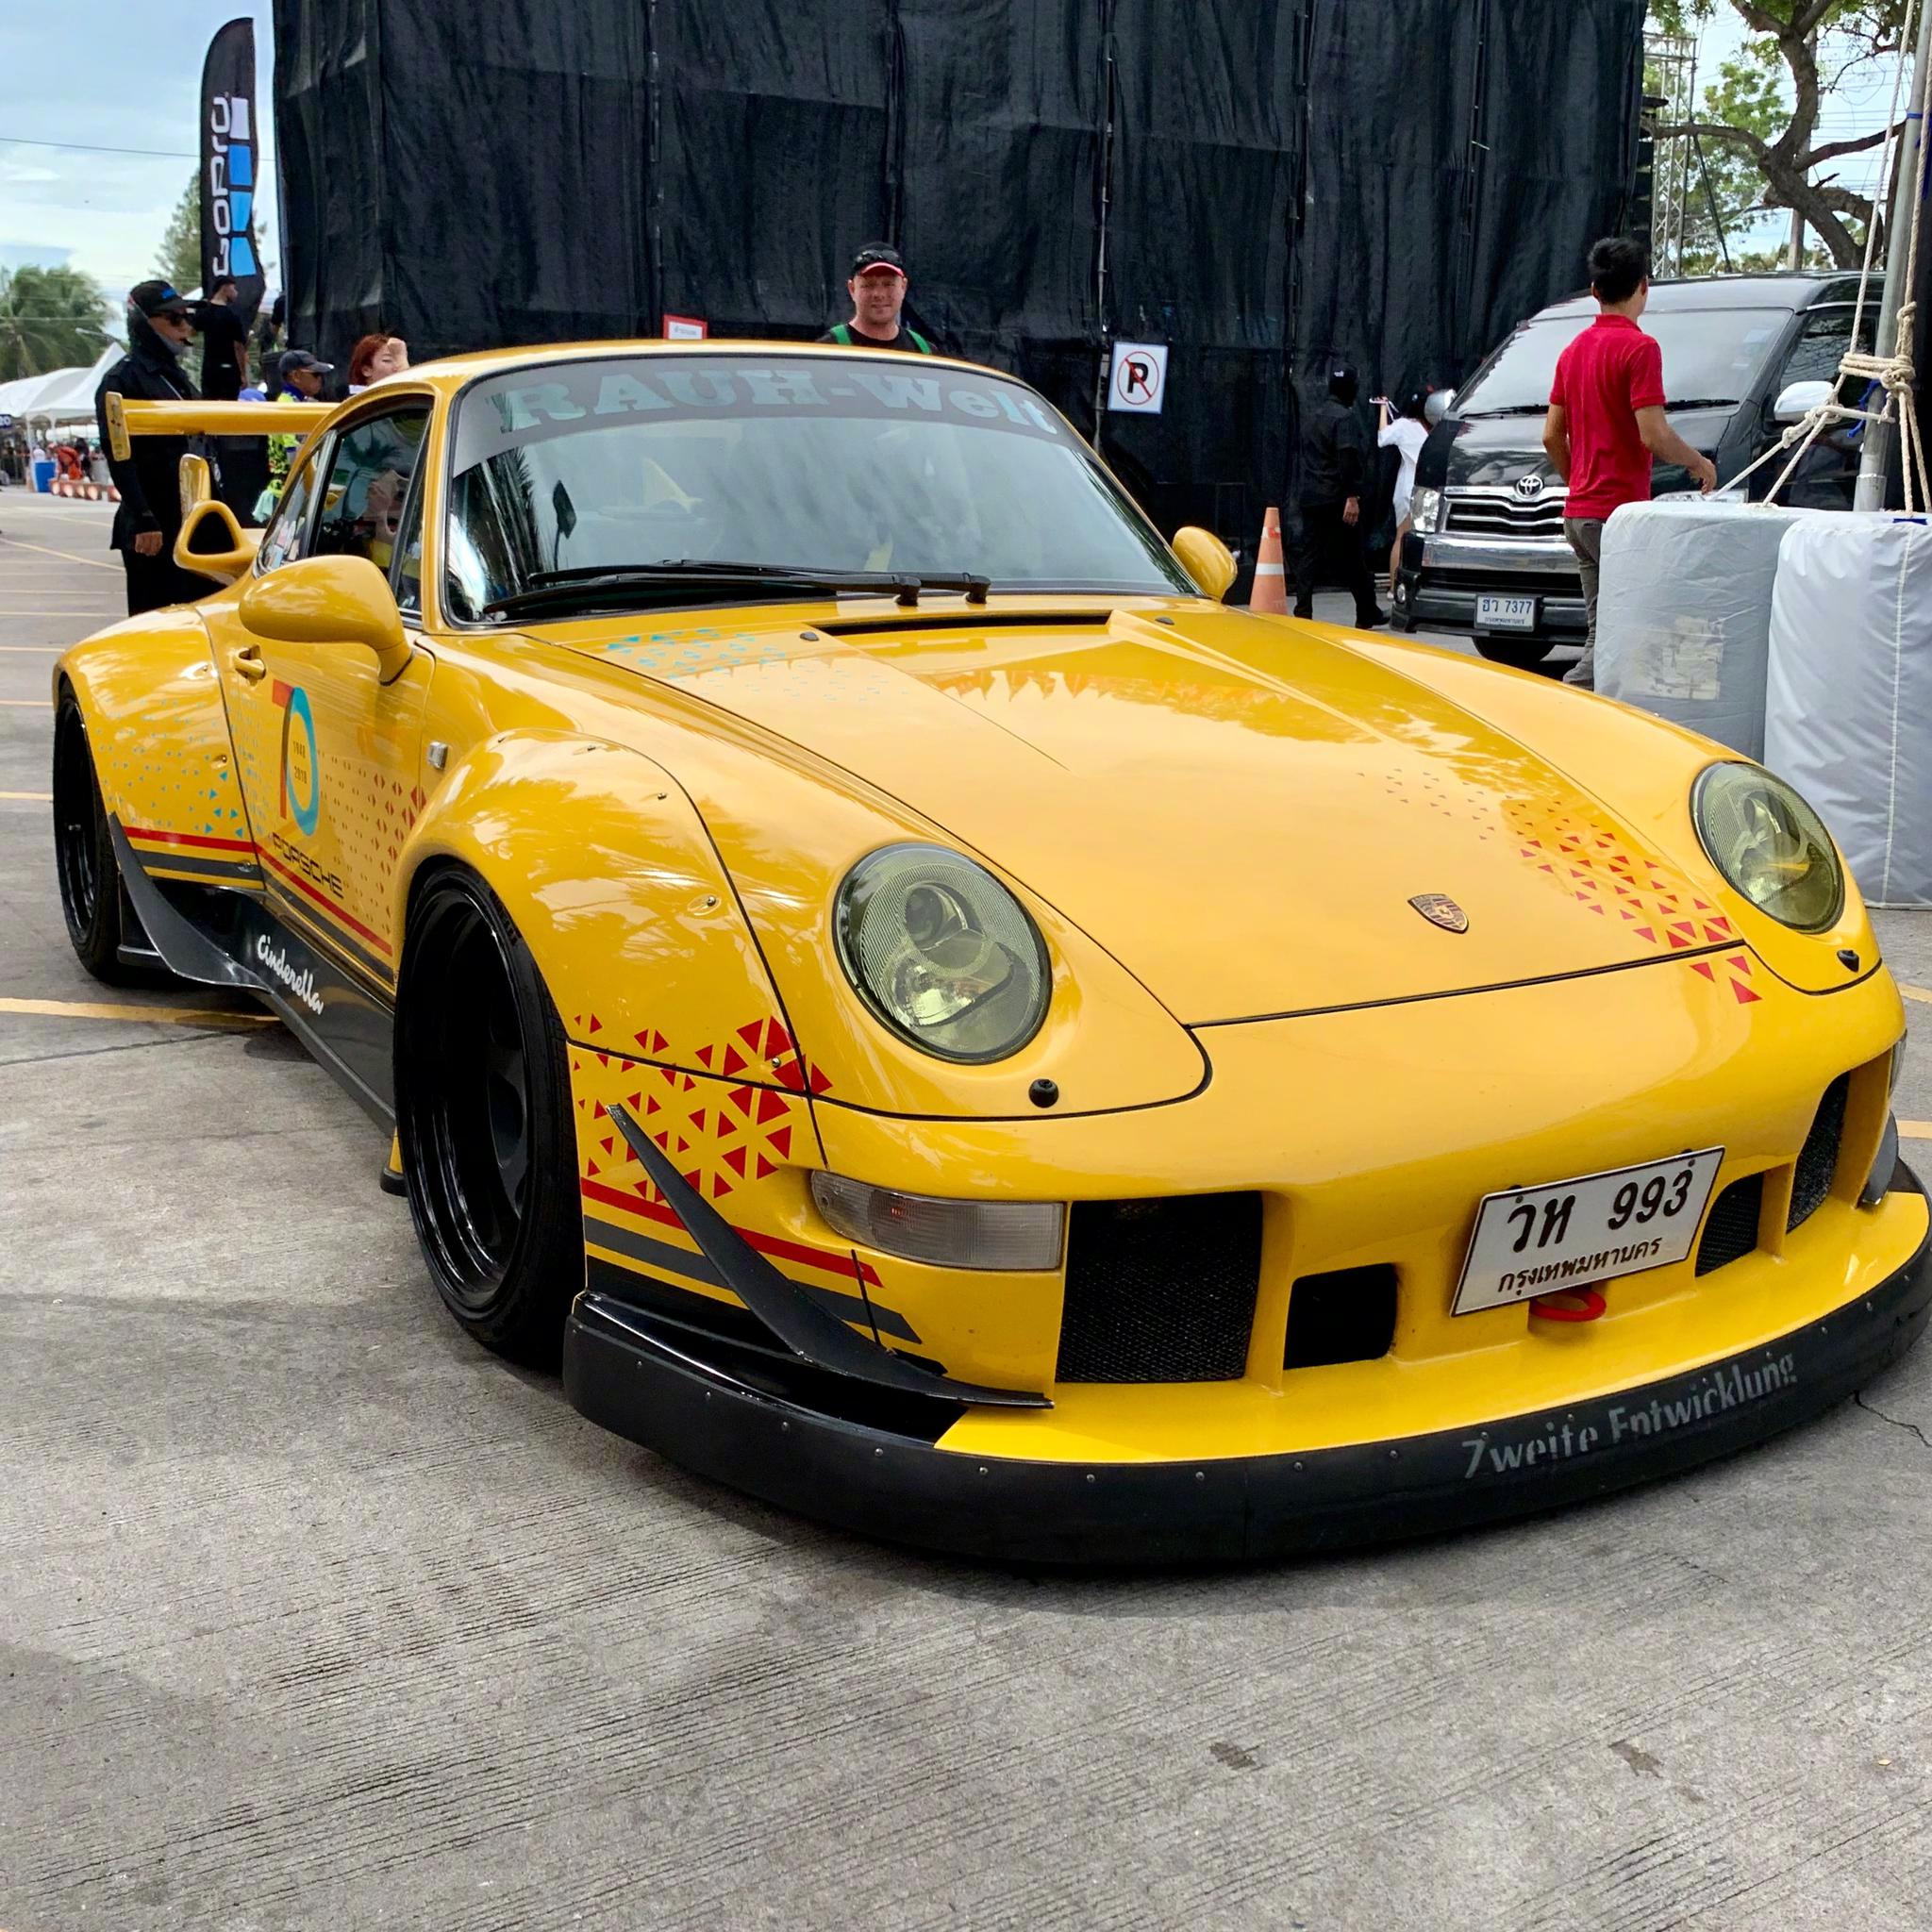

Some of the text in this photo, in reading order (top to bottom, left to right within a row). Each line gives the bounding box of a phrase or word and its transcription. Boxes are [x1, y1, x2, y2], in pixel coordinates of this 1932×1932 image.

[485, 369, 1058, 435] RAUH-Welt
[1127, 362, 1149, 393] P
[1505, 600, 1533, 614] 7377
[272, 831, 344, 899] PORSCHE
[258, 934, 324, 1015] Cinderella
[1607, 1169, 1693, 1230] 993
[1498, 1237, 1662, 1295] กรุงเทพมหานคร
